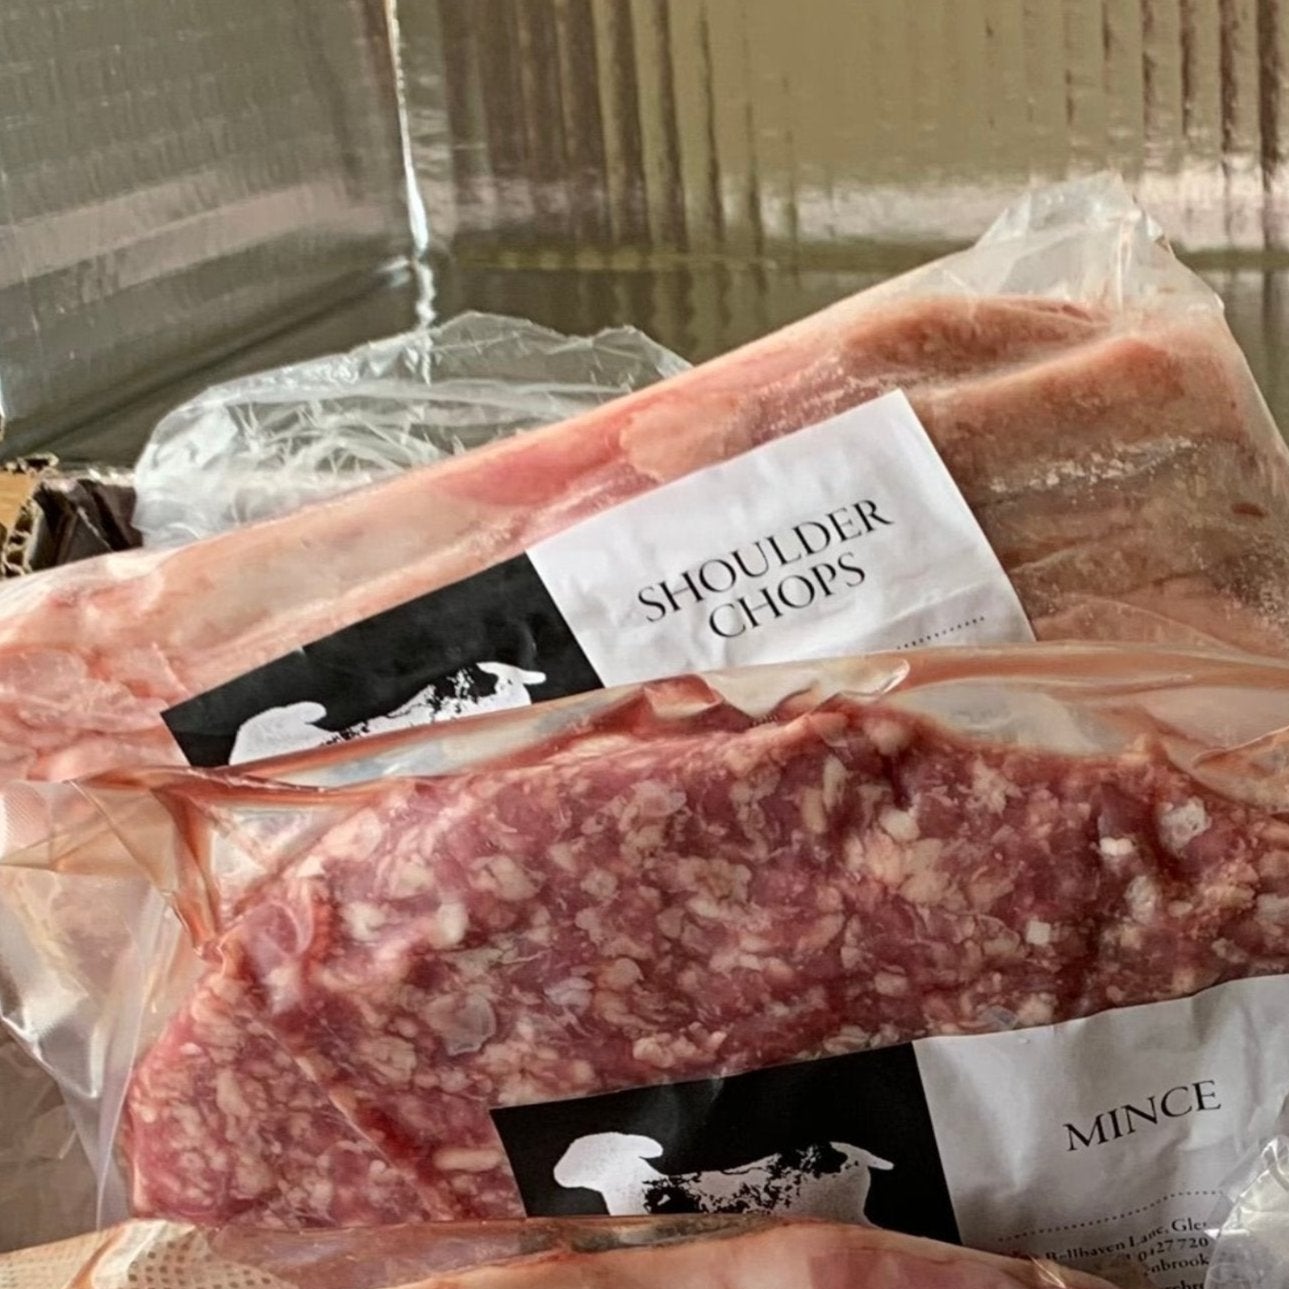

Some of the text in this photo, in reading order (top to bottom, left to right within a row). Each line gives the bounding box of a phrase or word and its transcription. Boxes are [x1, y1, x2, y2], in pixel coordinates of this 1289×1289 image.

[638, 499, 894, 622] SHOULDER
[709, 552, 866, 638] CHOPS
[1063, 1080, 1222, 1151] MINCE
